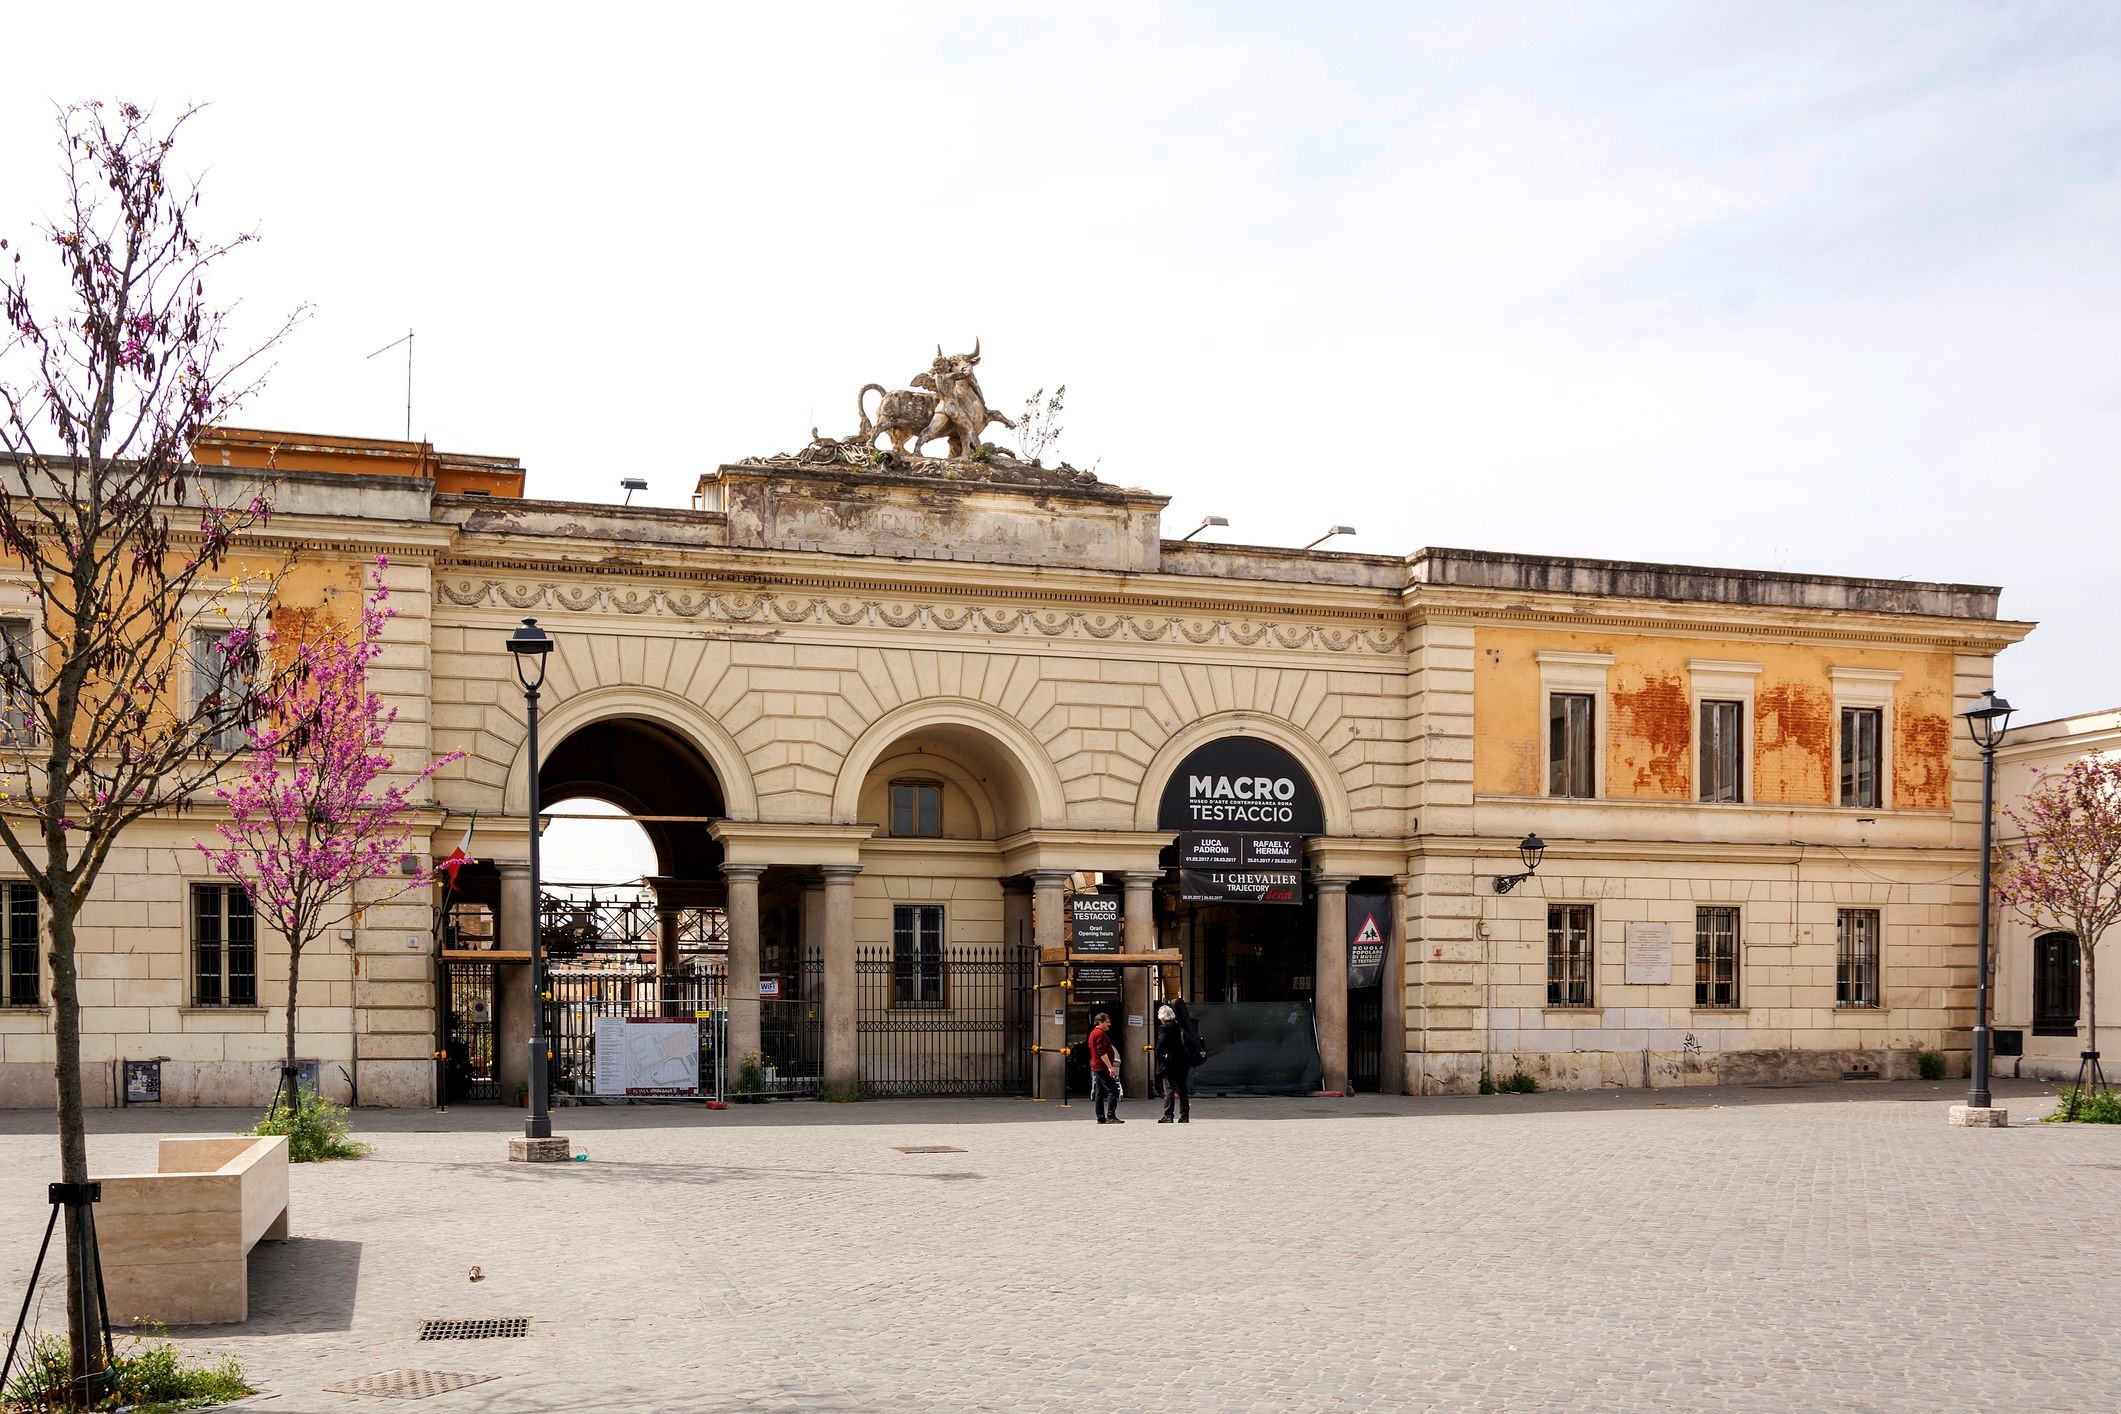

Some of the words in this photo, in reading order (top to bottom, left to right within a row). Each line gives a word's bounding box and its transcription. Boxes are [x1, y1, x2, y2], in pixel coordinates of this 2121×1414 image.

[1189, 776, 1295, 800] MACRO
[1190, 805, 1293, 822] TESTACCIO
[1201, 839, 1222, 847] LUCA
[1212, 873, 1224, 883] LI
[1228, 874, 1297, 884] CHEVALIER
[1257, 892, 1264, 902] of
[1266, 890, 1293, 900] desire
[1074, 901, 1117, 910] MACRO
